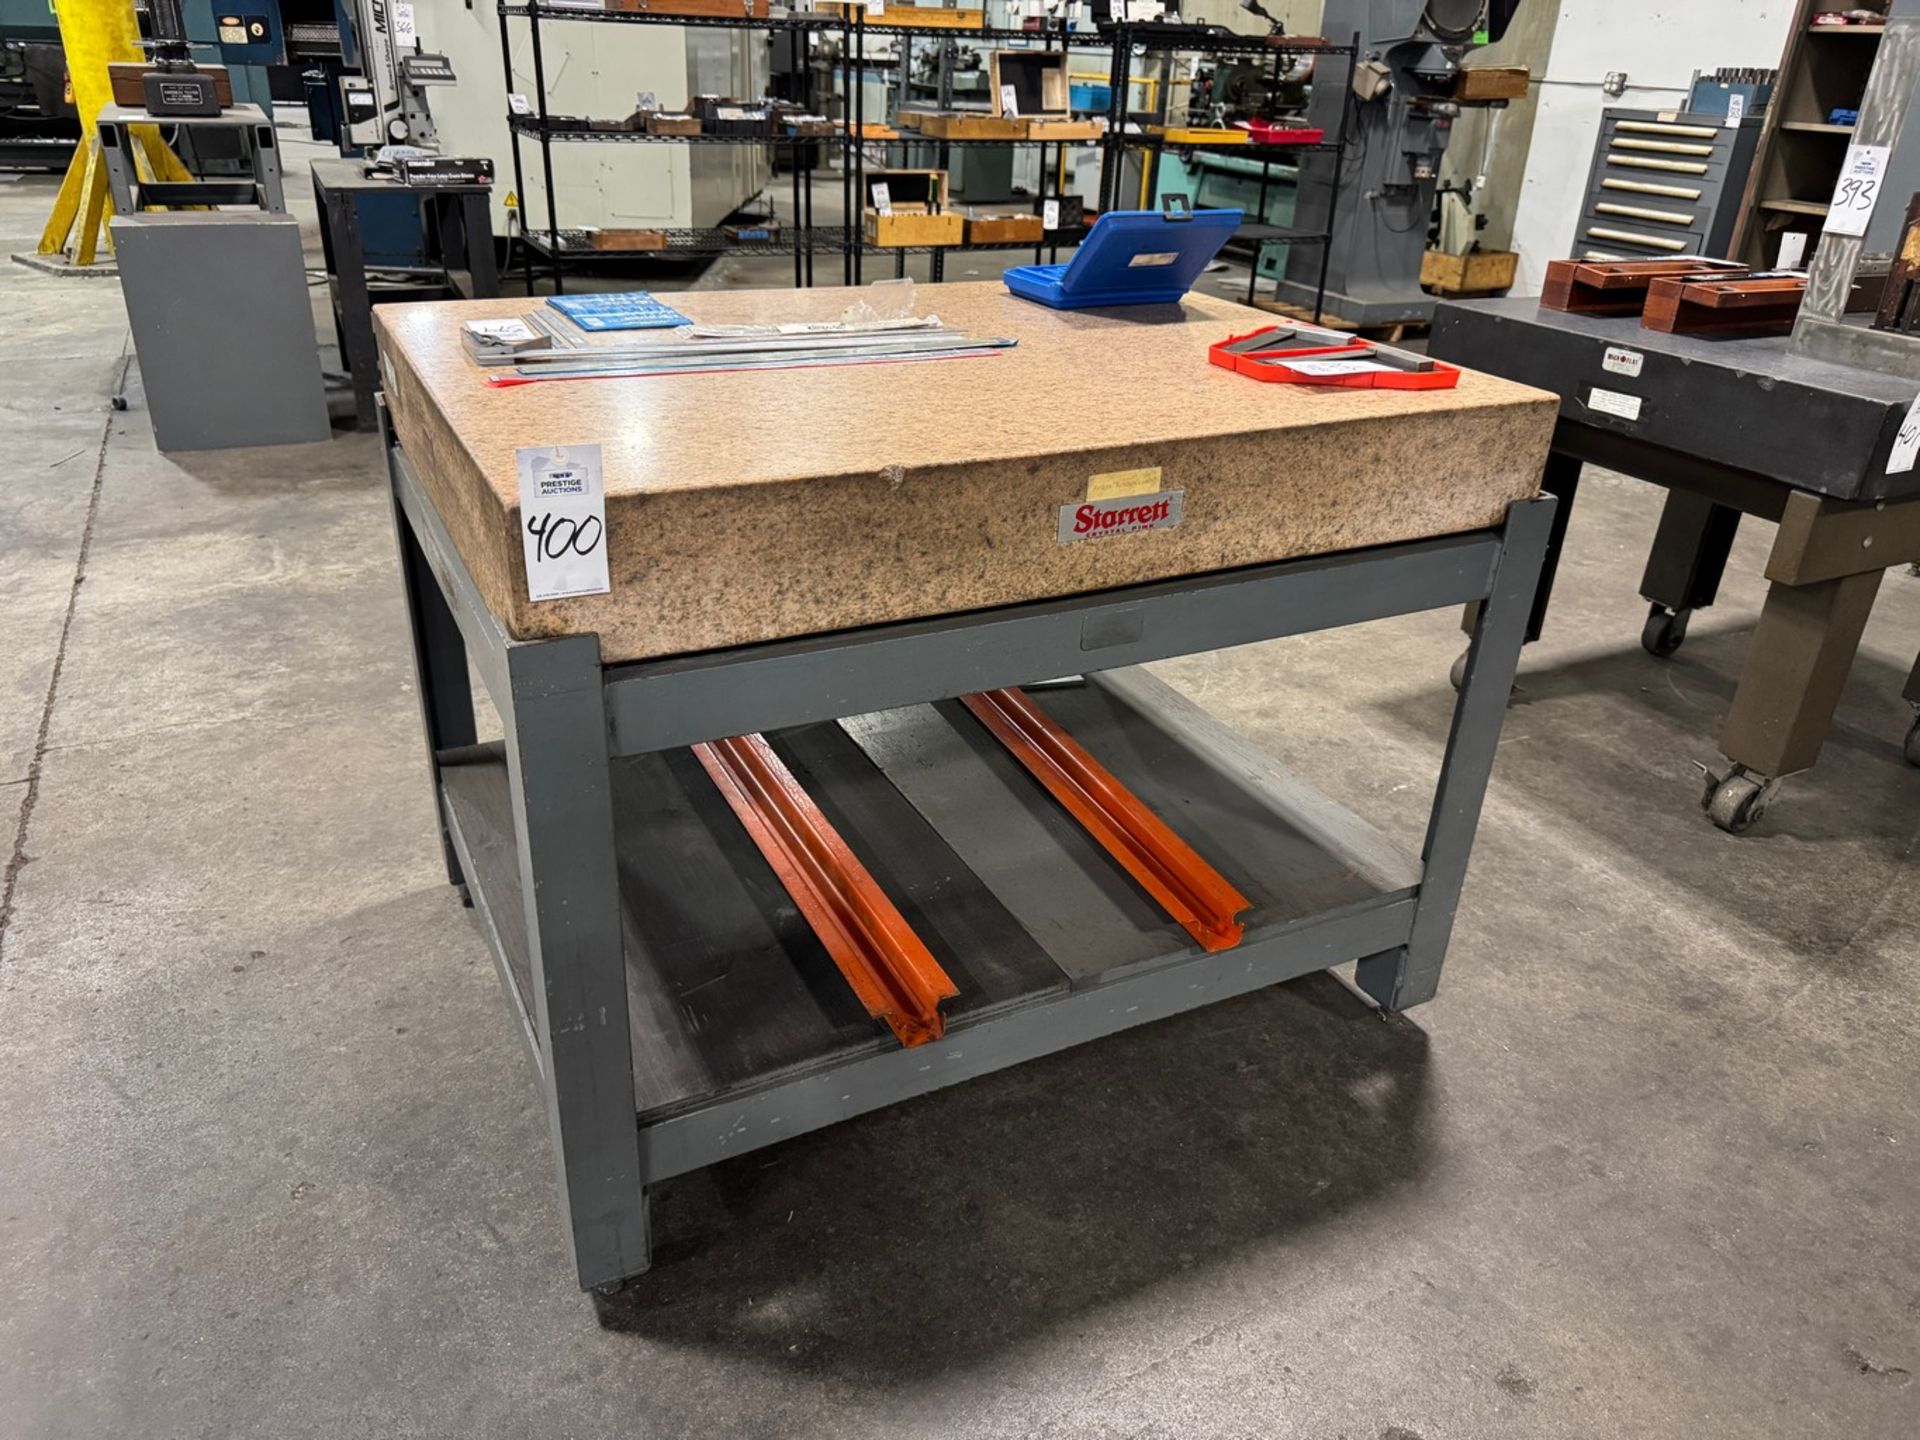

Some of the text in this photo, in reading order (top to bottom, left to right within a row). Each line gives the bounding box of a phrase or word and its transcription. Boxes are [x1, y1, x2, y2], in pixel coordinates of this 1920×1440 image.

[1833, 177, 1876, 211] 393
[540, 479, 582, 488] PRESTIGE
[541, 486, 583, 495] AUCTIONS
[1073, 499, 1170, 534] Starrett
[527, 512, 603, 563] 400
